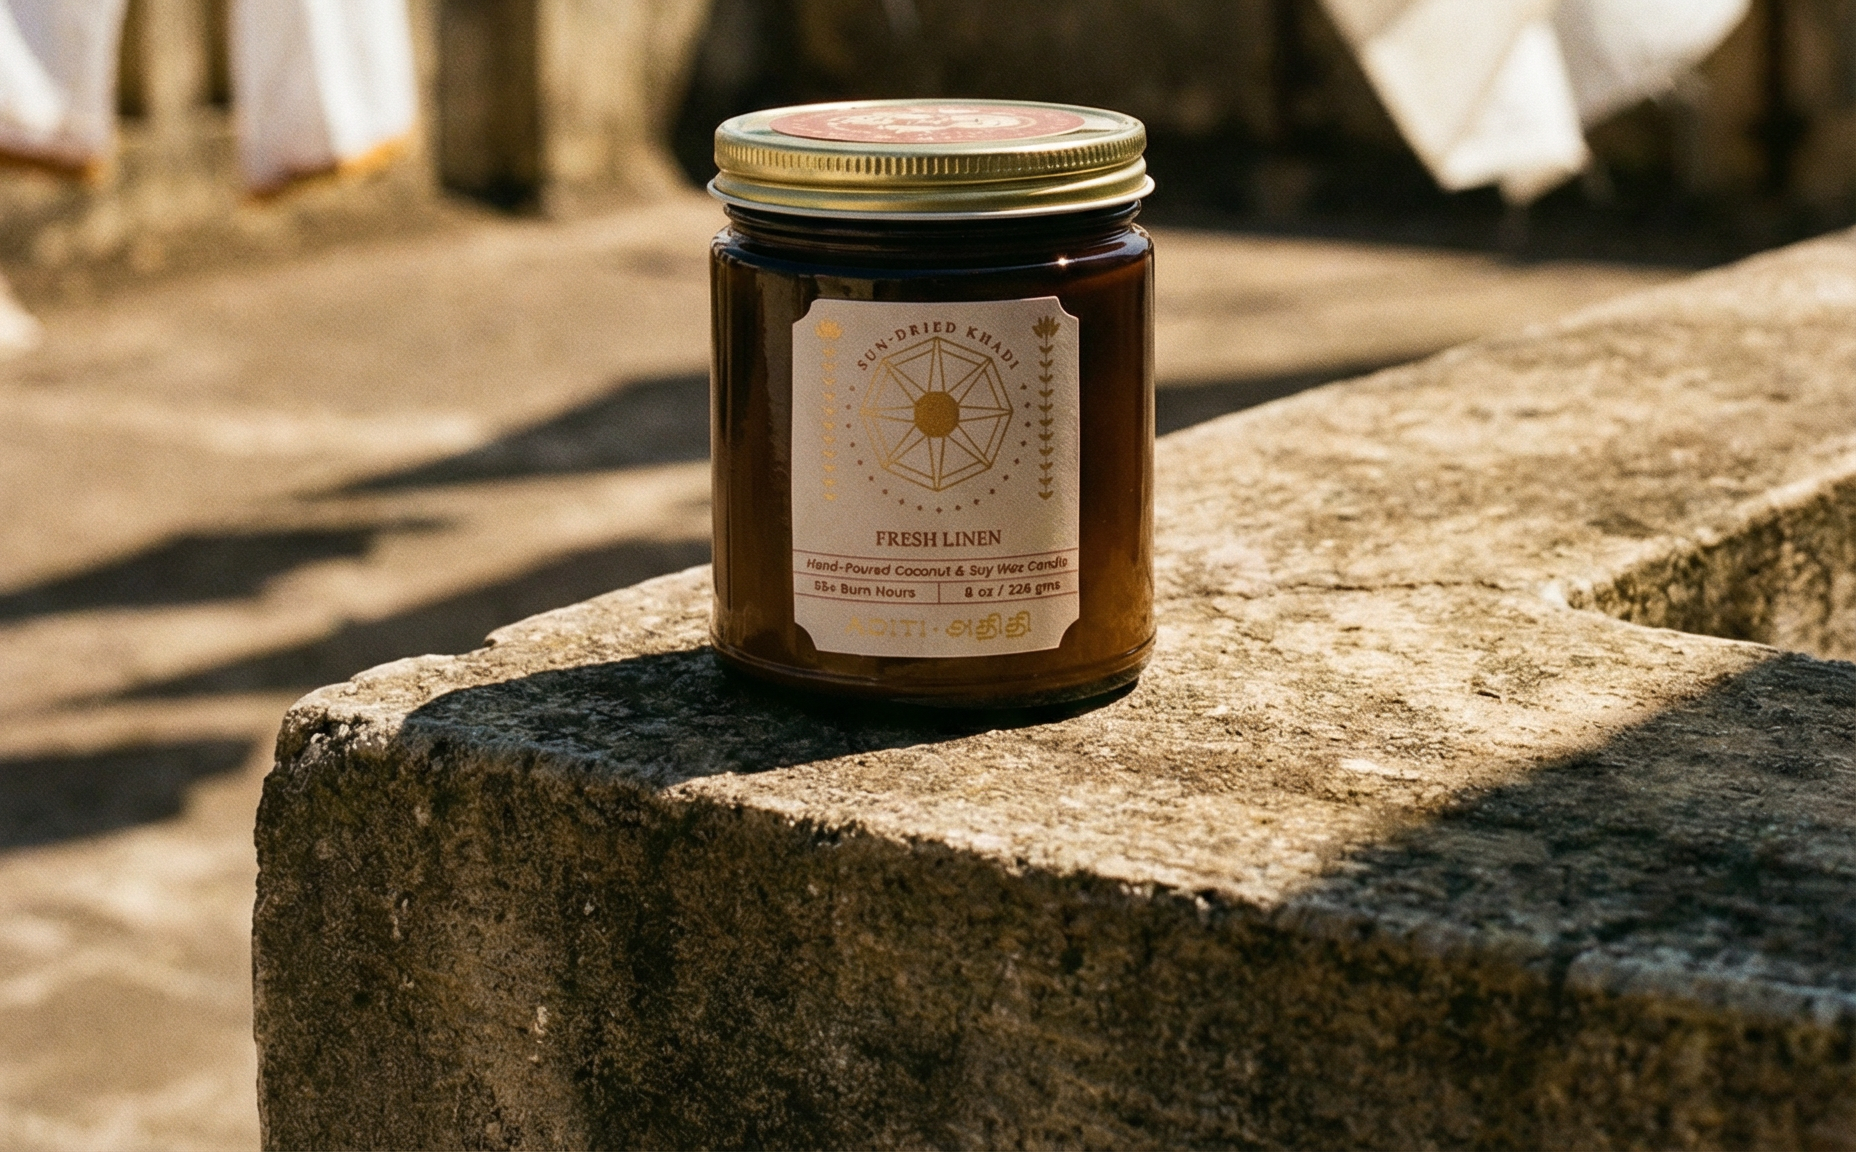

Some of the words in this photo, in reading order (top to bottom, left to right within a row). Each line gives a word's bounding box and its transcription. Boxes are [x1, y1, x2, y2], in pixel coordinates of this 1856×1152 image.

[857, 321, 956, 371] SUN-DRIED
[965, 325, 1019, 370] KHADI
[876, 530, 937, 547] FRESH
[943, 530, 1002, 547] LINEN
[895, 565, 951, 577] Coconut
[955, 565, 965, 577] &
[840, 583, 871, 596] Burn
